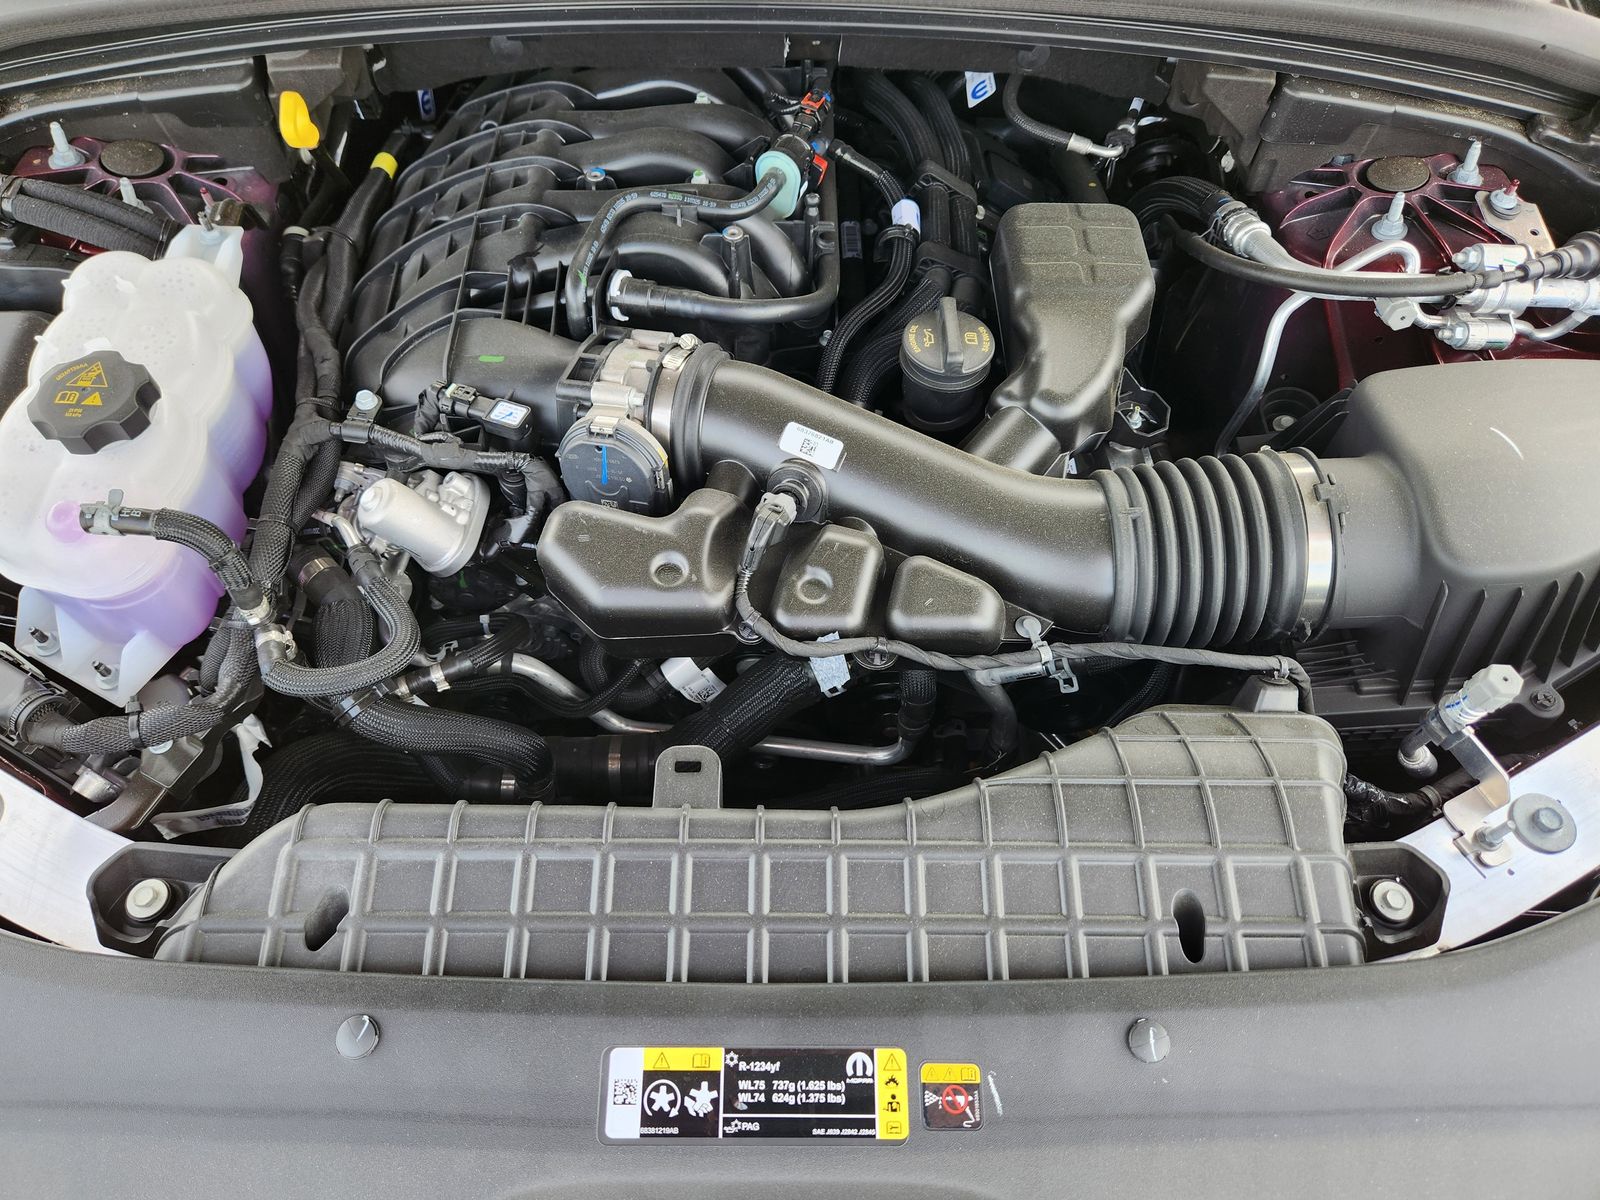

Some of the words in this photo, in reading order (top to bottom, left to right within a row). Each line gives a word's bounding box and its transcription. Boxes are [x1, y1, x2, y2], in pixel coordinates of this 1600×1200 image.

[738, 1061, 781, 1073] R-1234yf
[738, 1080, 766, 1090] WL75
[772, 1080, 796, 1092] 737g
[797, 1080, 826, 1092] (1.625
[827, 1080, 846, 1092] lbs)
[738, 1093, 766, 1103] WL74
[772, 1093, 796, 1105] 624g
[797, 1093, 826, 1105] (1.375
[827, 1093, 846, 1105] lbs)
[741, 1122, 760, 1131] PAG
